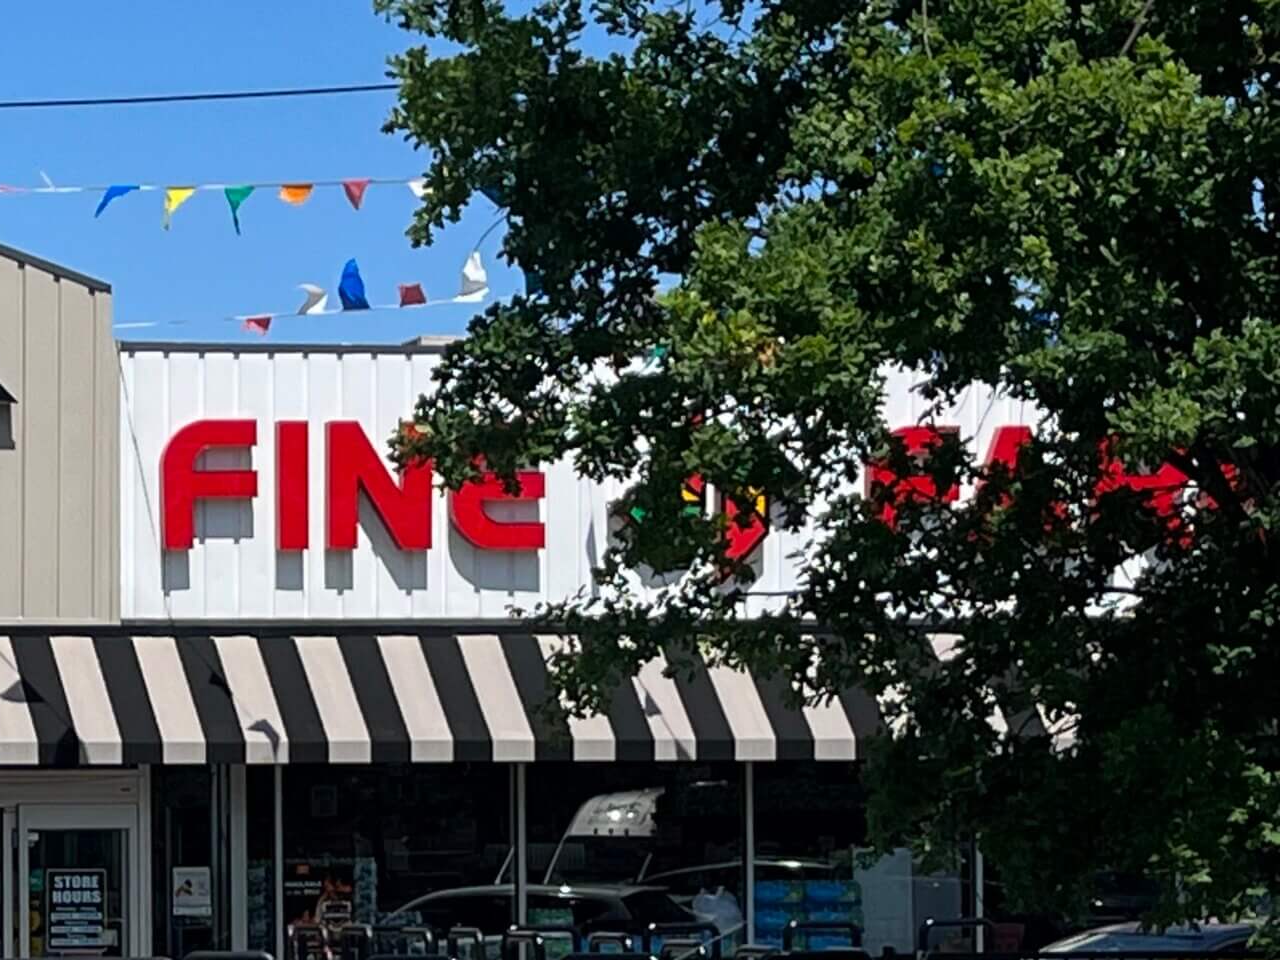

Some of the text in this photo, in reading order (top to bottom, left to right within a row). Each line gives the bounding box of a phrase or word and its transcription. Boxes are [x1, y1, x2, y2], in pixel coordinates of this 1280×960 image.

[160, 419, 545, 549] FINE
[53, 875, 100, 889] STORE
[51, 890, 102, 904] HOURS
